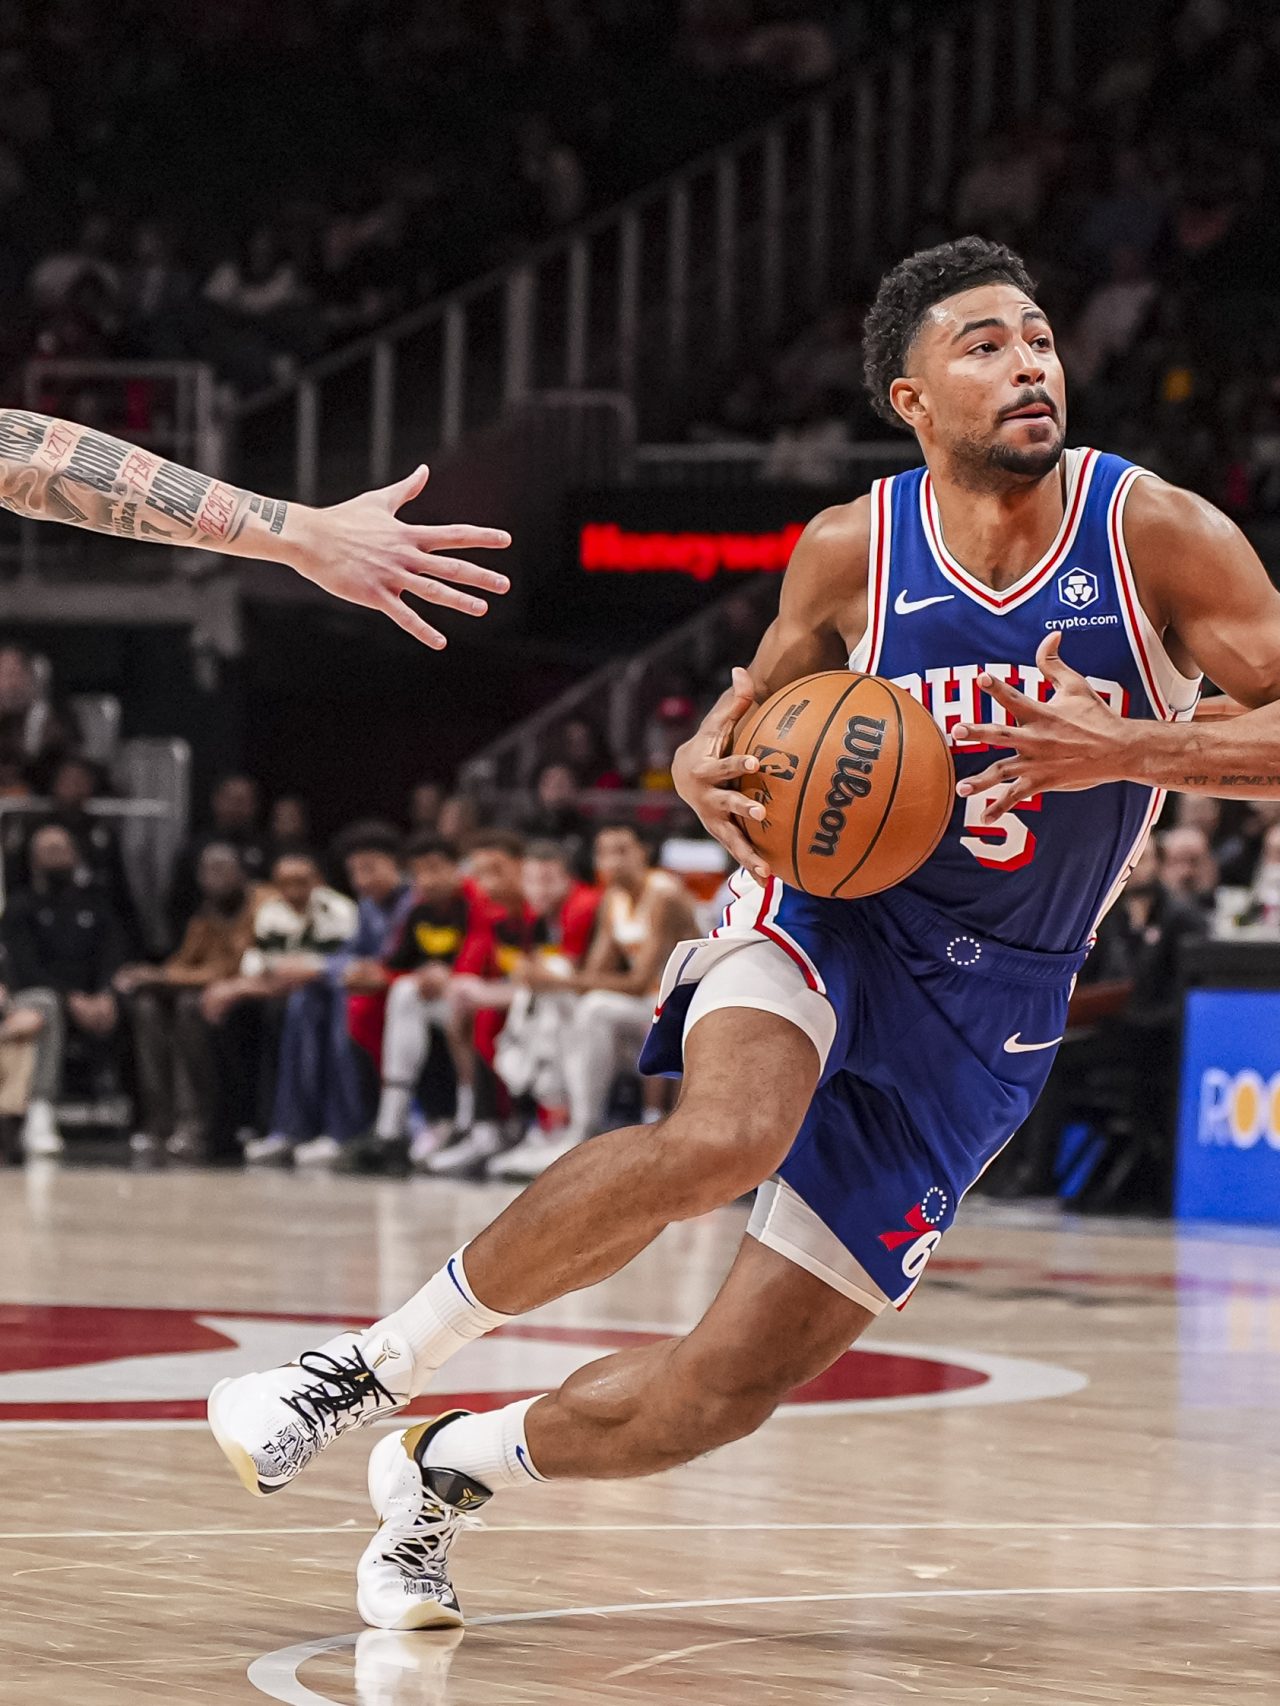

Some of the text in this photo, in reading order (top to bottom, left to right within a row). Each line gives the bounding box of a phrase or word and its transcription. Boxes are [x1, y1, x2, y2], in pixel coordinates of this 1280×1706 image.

[1045, 615, 1118, 630] crypto.com
[808, 715, 887, 857] Wilson
[960, 783, 1042, 870] 5
